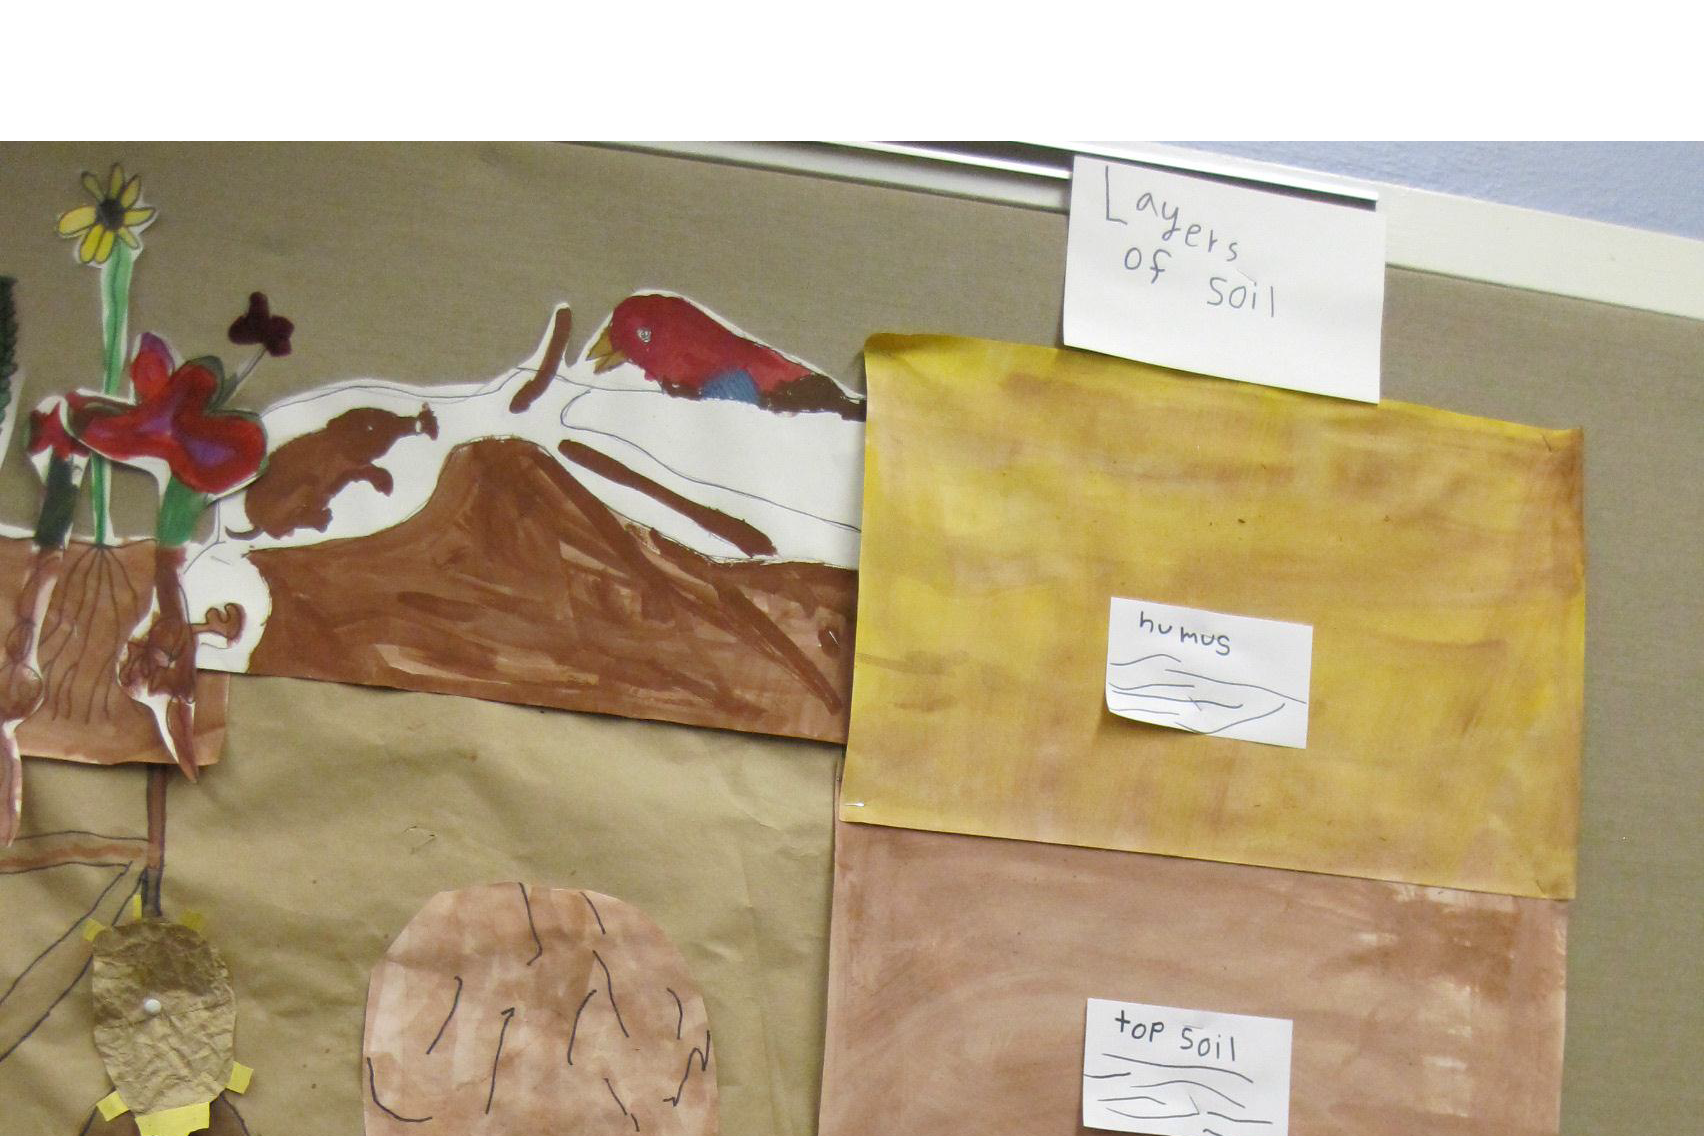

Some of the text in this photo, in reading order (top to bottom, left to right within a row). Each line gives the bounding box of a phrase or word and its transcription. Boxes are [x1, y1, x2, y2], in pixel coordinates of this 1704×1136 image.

[1104, 164, 1239, 263] Layers
[1139, 611, 1231, 657] humus
[1114, 1009, 1166, 1043] top
